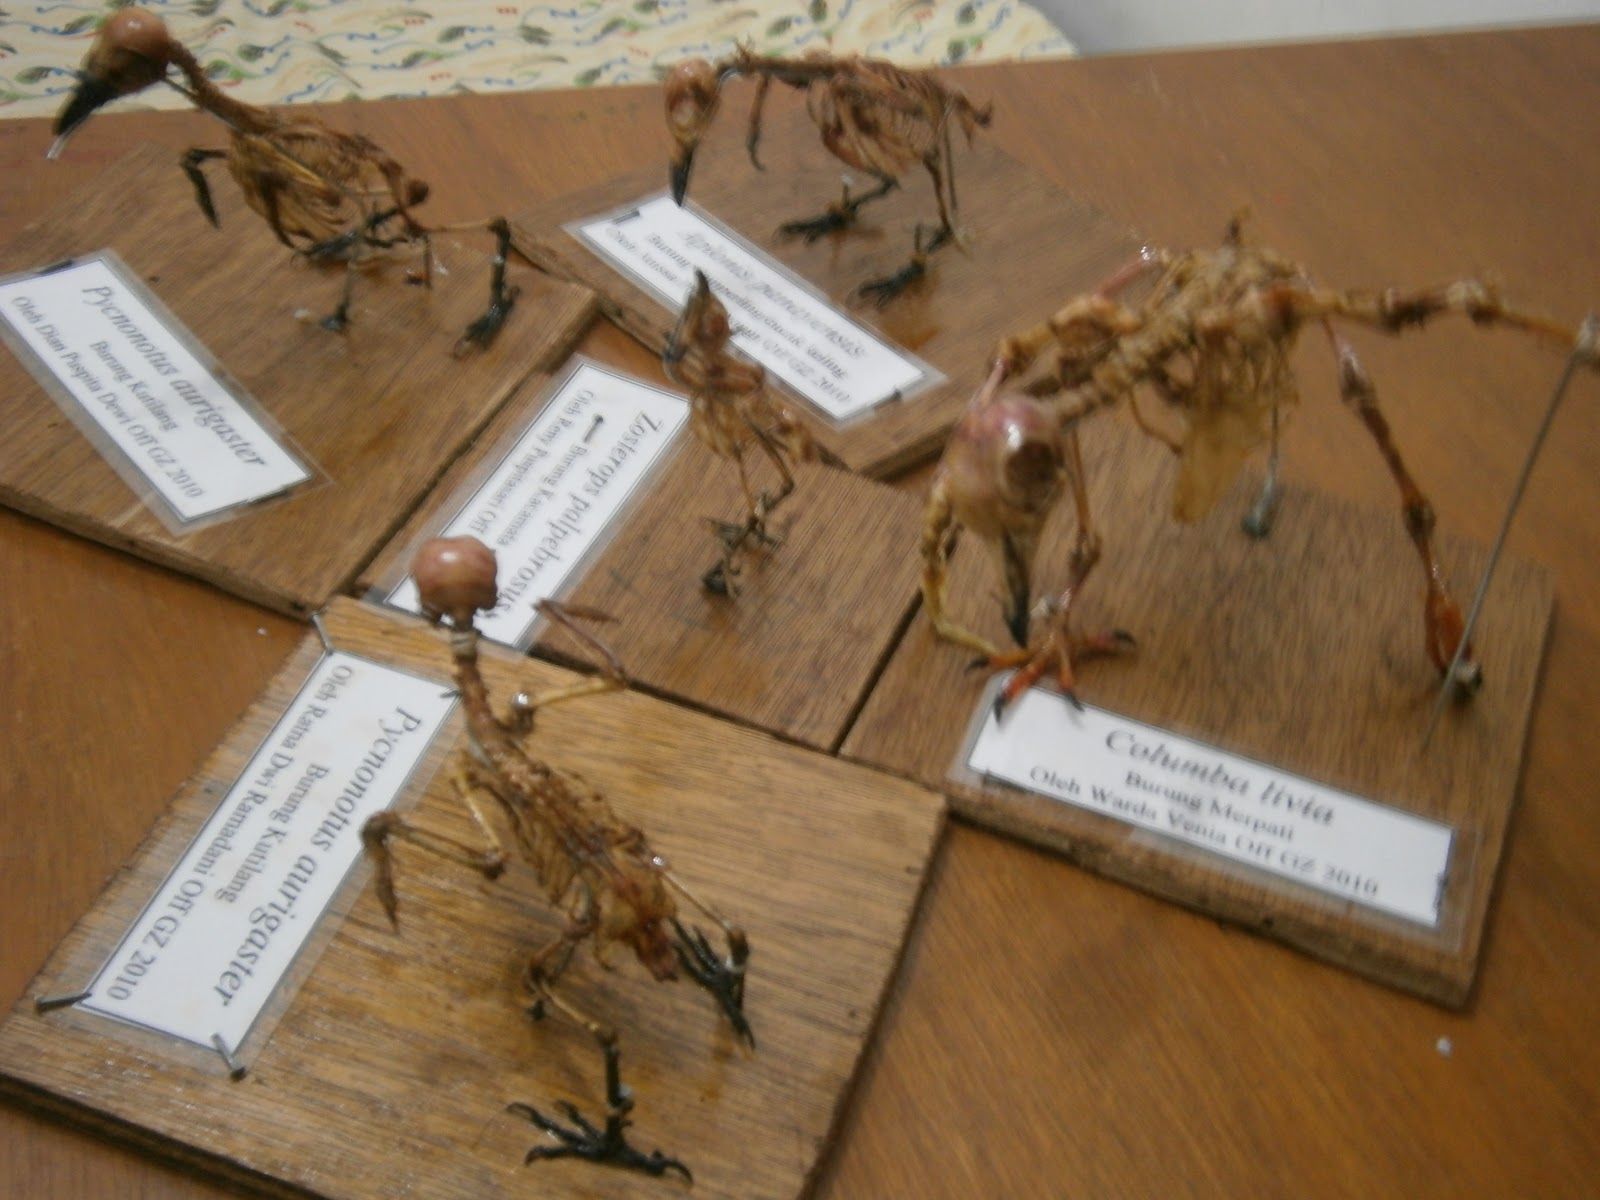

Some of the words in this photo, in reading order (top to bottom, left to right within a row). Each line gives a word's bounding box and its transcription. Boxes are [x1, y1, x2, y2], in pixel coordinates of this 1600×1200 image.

[81, 286, 180, 376] Pycnonotus
[169, 379, 267, 466] aurigaster
[89, 340, 134, 383] Burung
[127, 380, 179, 432] Kutilang
[165, 468, 206, 499] 2010
[583, 411, 662, 496] Zosterops
[314, 665, 354, 701] Oleh
[280, 704, 328, 749] Ratna
[254, 752, 294, 787] Dwi
[268, 763, 330, 824] Burung
[310, 706, 422, 851] Pycnonotus
[1029, 766, 1080, 795] Oleh
[1105, 730, 1249, 796] Columba
[1260, 780, 1334, 826] livia
[193, 790, 269, 877] Ramadani
[1125, 770, 1202, 812] Burung
[1209, 798, 1294, 842] Merpati
[168, 879, 205, 914] Off
[214, 826, 288, 904] Kutilang
[142, 915, 180, 948] GZ
[213, 854, 317, 1007] aurigaster
[106, 950, 157, 1001] 2010
